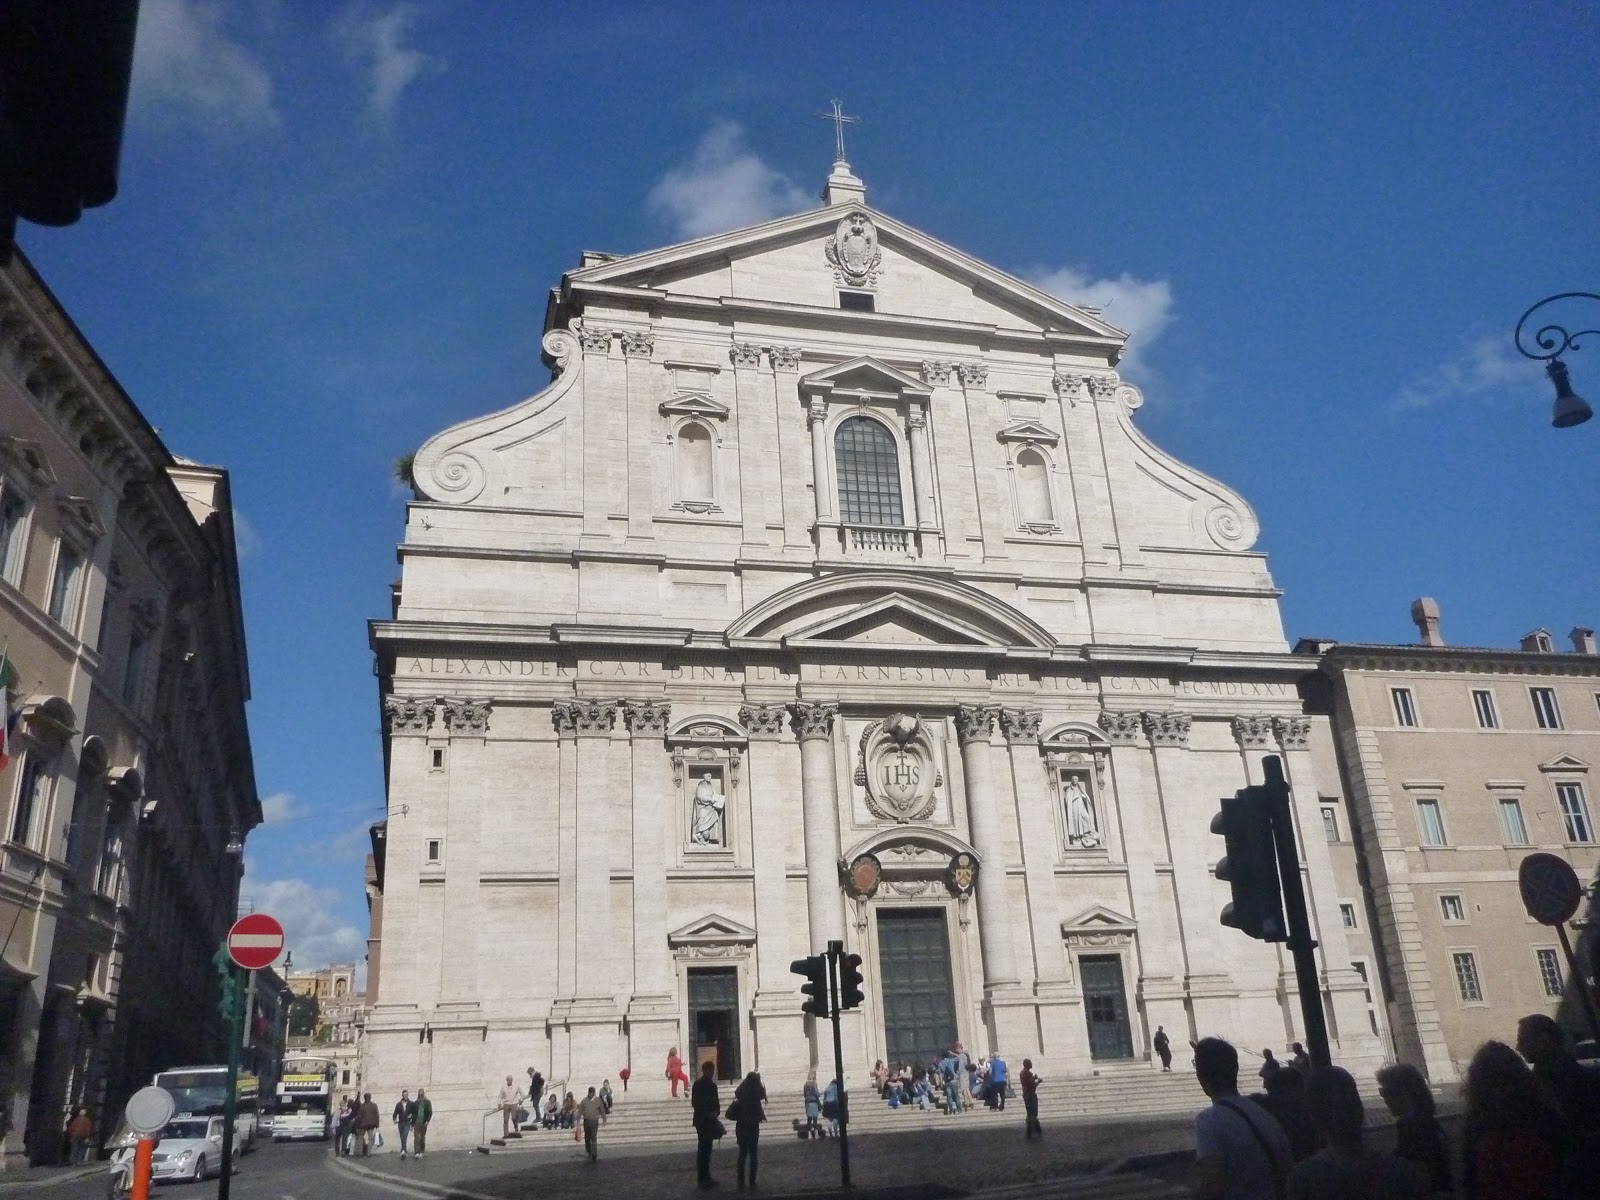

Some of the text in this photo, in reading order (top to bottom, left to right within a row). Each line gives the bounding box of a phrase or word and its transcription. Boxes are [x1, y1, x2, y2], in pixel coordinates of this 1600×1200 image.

[410, 657, 569, 677] ALEXANDER
[818, 664, 971, 683] FARNESIVS
[884, 765, 920, 786] IHS
